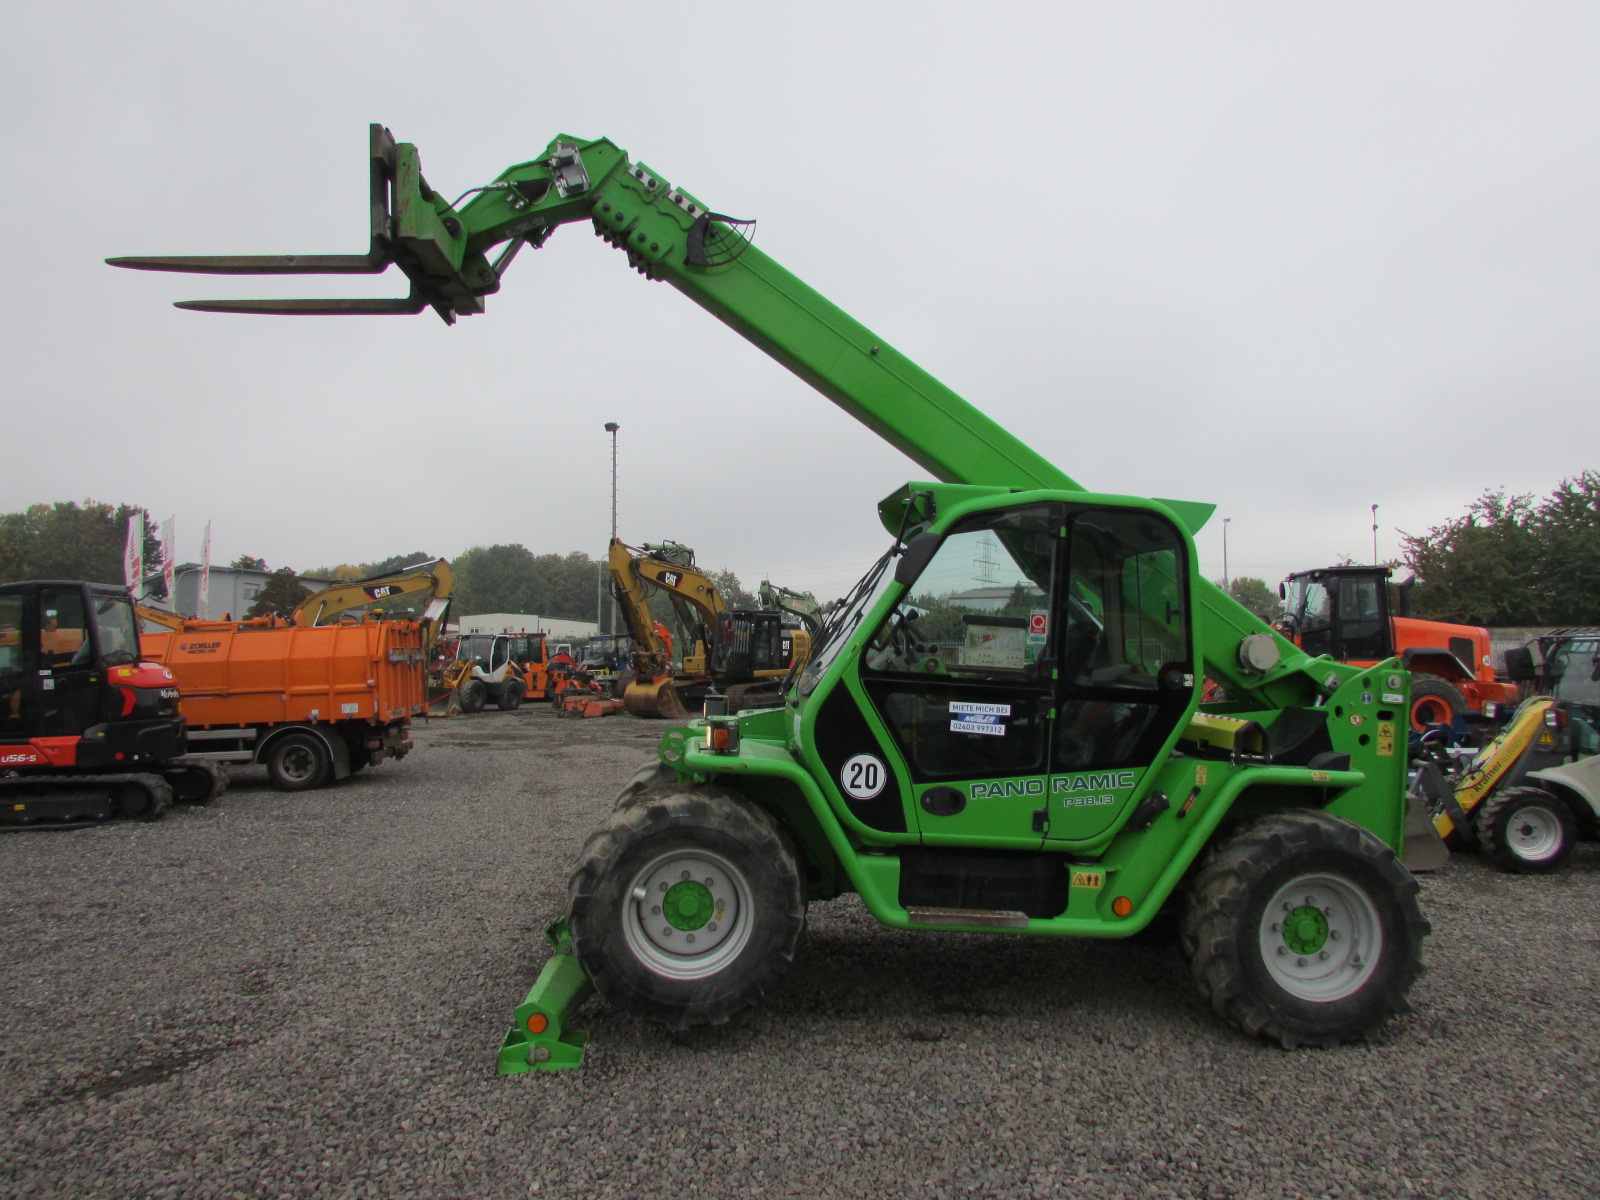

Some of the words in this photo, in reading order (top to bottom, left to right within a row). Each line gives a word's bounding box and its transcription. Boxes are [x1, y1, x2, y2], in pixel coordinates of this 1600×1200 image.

[665, 571, 677, 587] CAT
[374, 586, 391, 599] CAT
[952, 704, 974, 712] MIETE
[975, 705, 993, 713] MICH
[996, 706, 1008, 714] BEI
[953, 723, 975, 731] 02403
[976, 725, 1002, 733] 997312
[850, 762, 878, 789] 20
